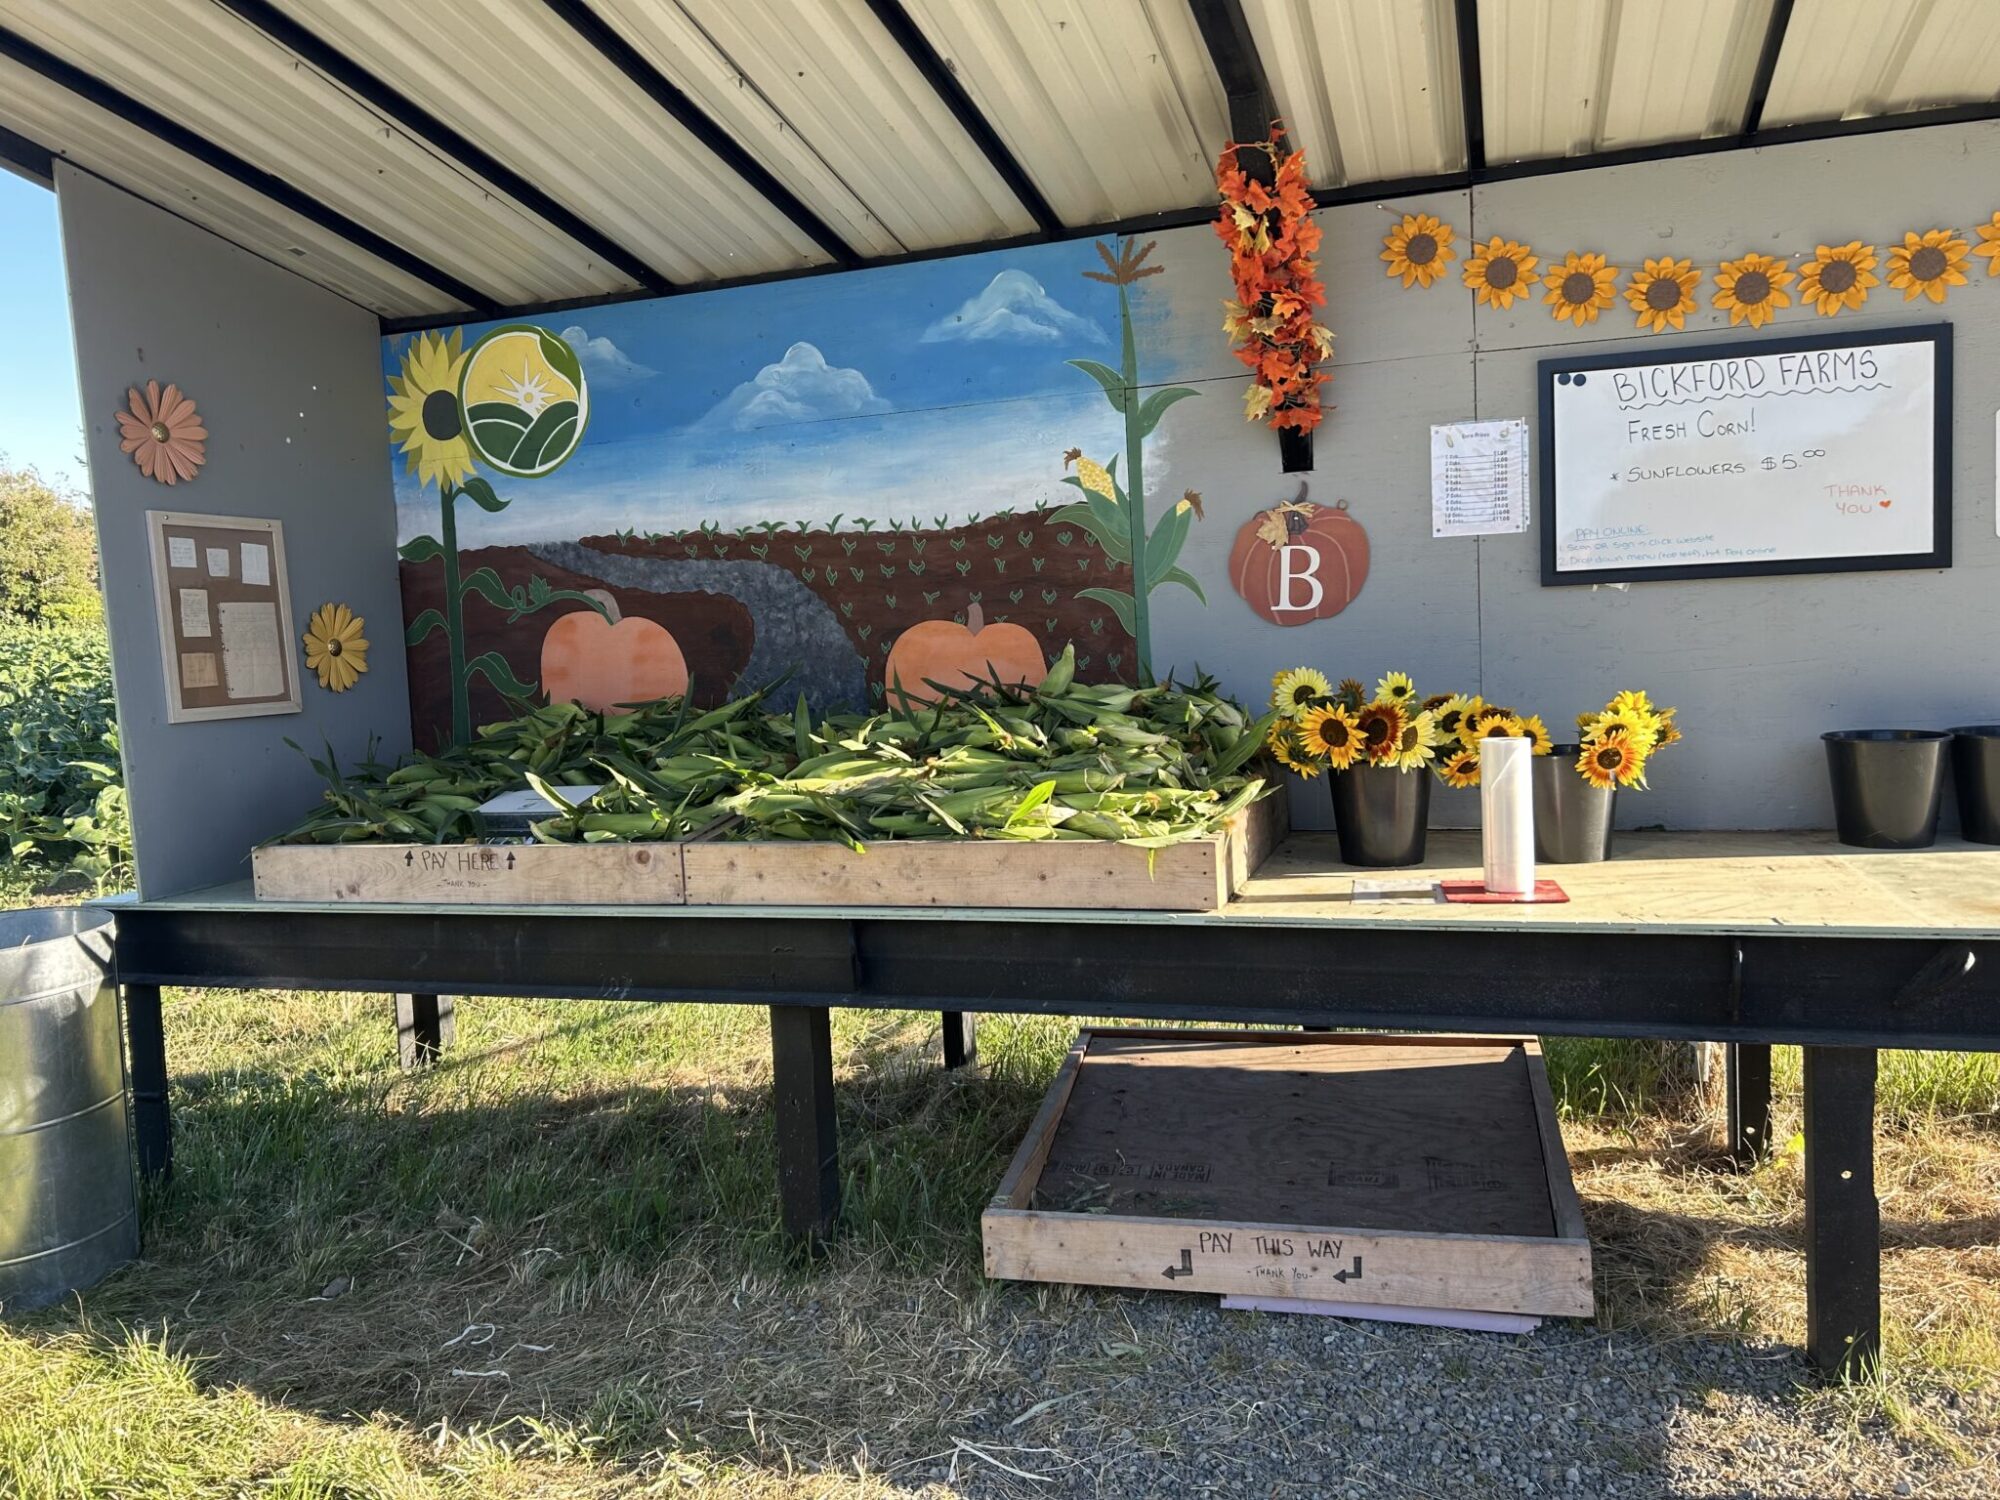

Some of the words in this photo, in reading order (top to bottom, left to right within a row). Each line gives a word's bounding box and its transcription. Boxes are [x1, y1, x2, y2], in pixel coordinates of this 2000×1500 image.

[1613, 358, 1765, 401] BICKFORD
[1779, 350, 1878, 386] FARMS
[1628, 419, 1687, 443] FRESH
[1697, 407, 1756, 438] CORN!
[1627, 462, 1746, 482] SUNFLOWERS
[1823, 484, 1887, 498] THANK
[1836, 502, 1872, 516] YOU
[1271, 544, 1323, 612] B
[421, 850, 447, 872] PAY
[457, 851, 500, 873] HERE
[1199, 1232, 1232, 1253] PAY
[1250, 1236, 1294, 1257] THIS
[1307, 1240, 1343, 1259] WAY
